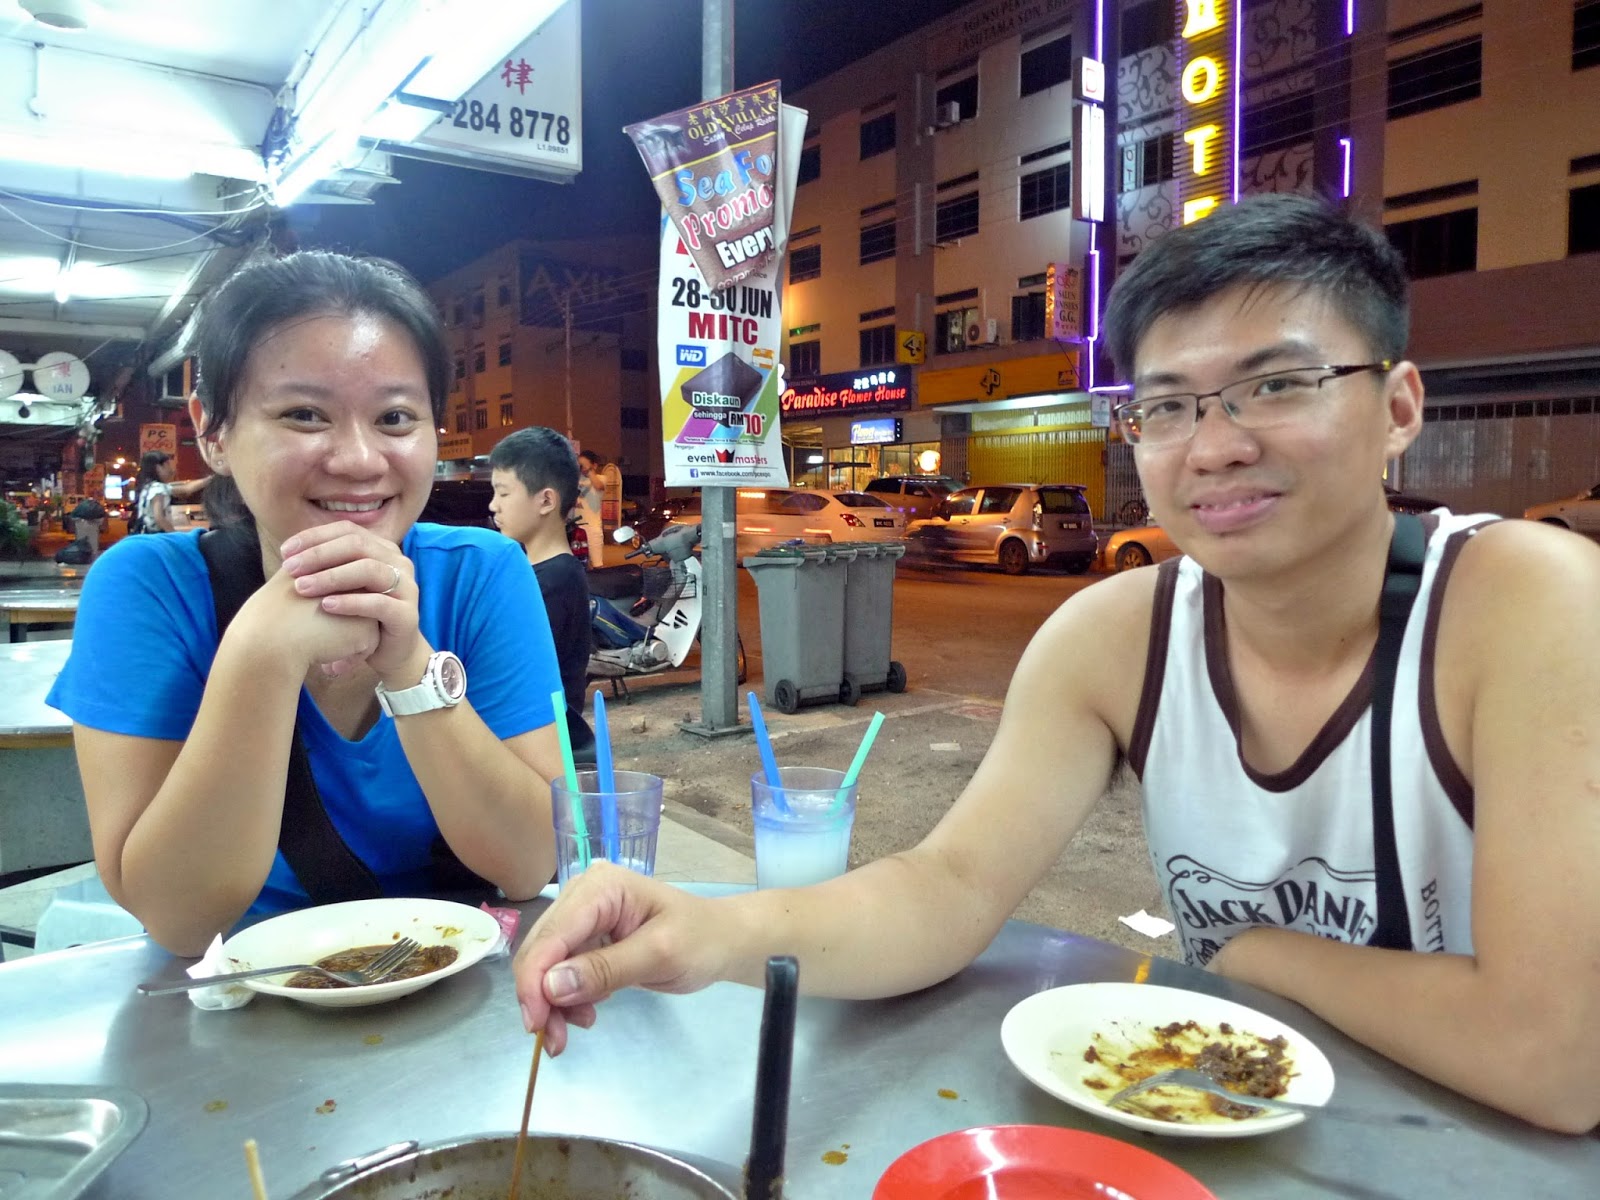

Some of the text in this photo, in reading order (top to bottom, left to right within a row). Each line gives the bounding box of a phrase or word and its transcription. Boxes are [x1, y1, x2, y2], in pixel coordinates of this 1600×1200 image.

[501, 58, 535, 96] 律
[436, 99, 571, 146] -284 8778
[687, 121, 718, 140] OLD
[677, 150, 775, 208] Sea Fo
[671, 277, 773, 319] 28-30 JUN
[688, 311, 759, 345] MITC
[679, 348, 704, 362] WD
[693, 393, 740, 406] Diskaun
[781, 387, 837, 411] Paradise
[839, 389, 872, 408] Flower
[875, 385, 907, 402] House
[693, 411, 727, 420] sehingga
[147, 430, 167, 438] PC
[687, 454, 768, 465] event masters
[1176, 888, 1278, 930] JACK
[1420, 878, 1445, 953] BOTT
